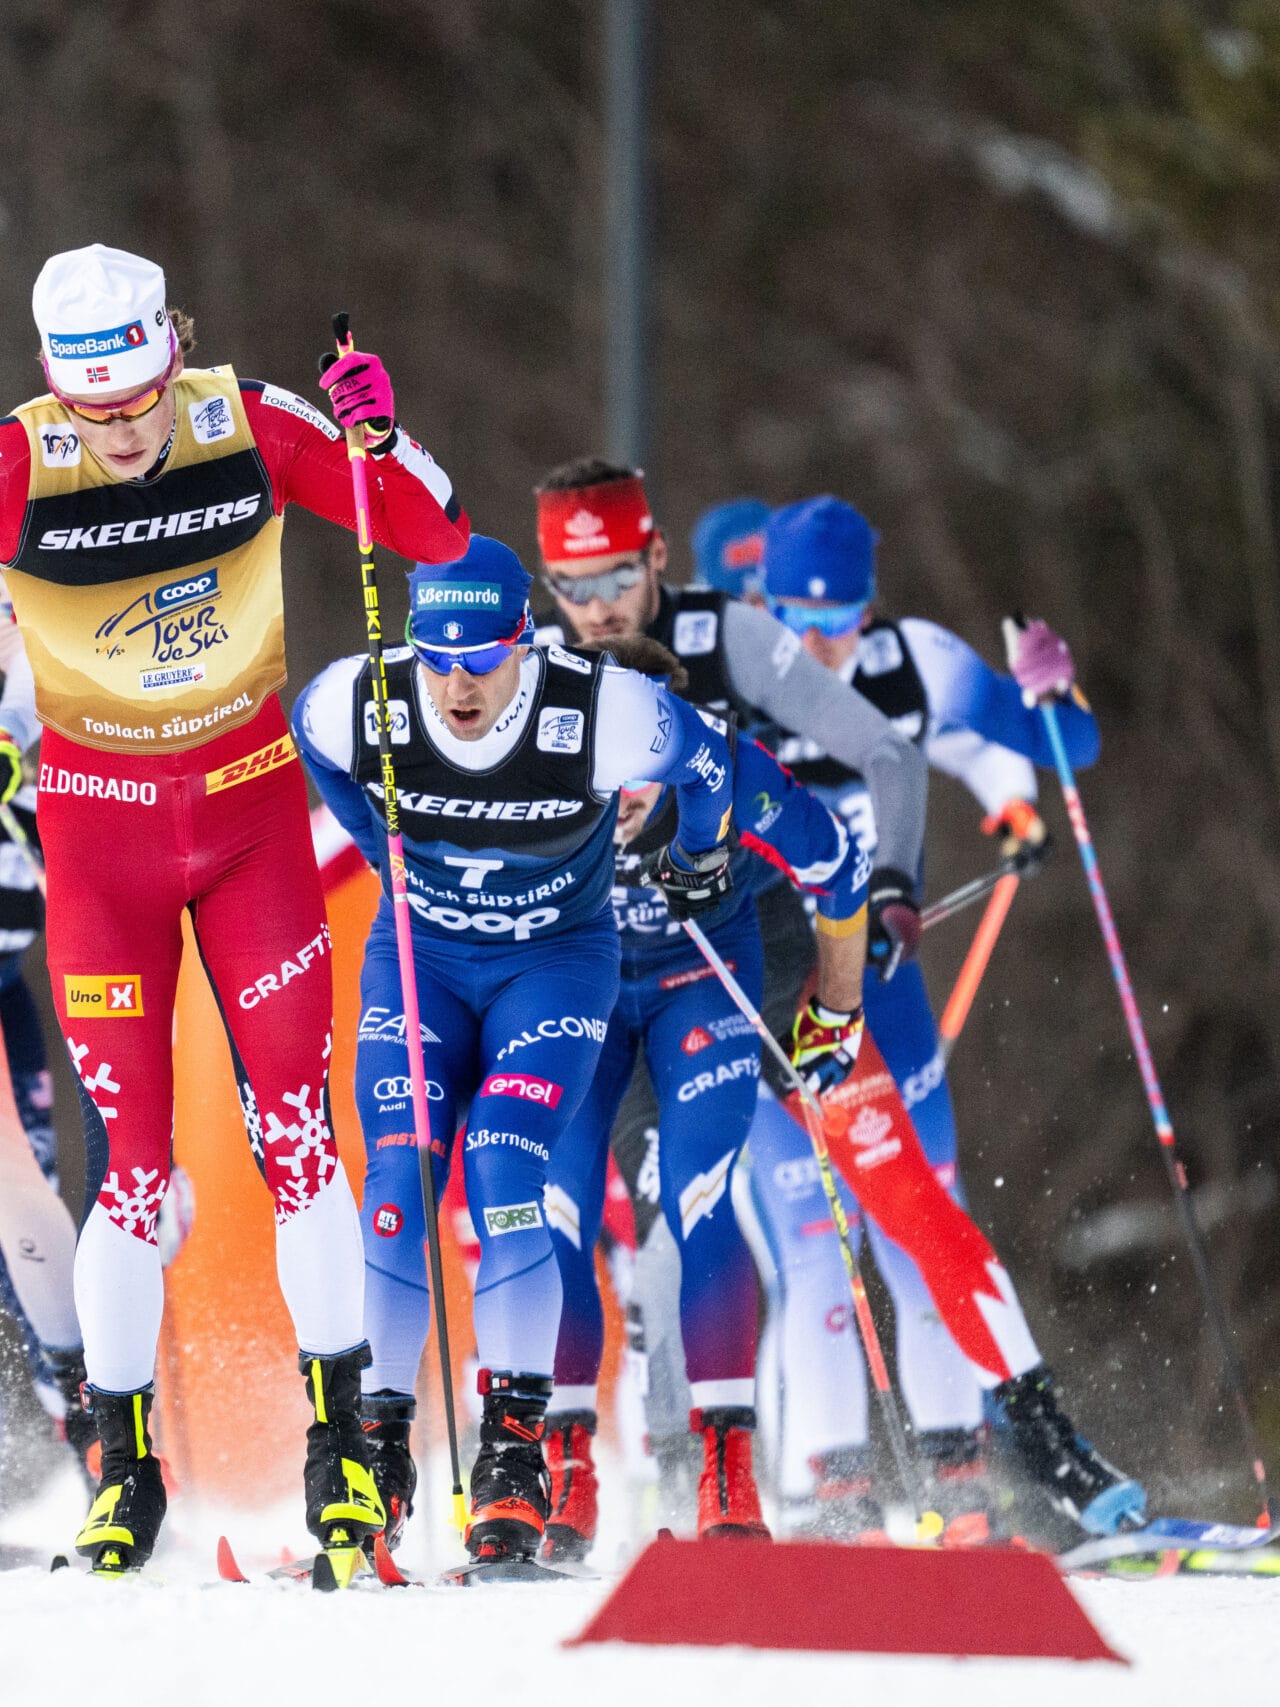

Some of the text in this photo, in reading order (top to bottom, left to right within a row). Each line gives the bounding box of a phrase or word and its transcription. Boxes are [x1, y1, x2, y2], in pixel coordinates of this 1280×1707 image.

[50, 334, 126, 357] SpareBank
[263, 393, 336, 440] TORGHATTEN
[38, 494, 261, 550] SKECHERS
[161, 576, 212, 601] coop
[361, 562, 381, 640] LEKI
[158, 640, 184, 663] de
[143, 674, 154, 684] LE
[82, 717, 155, 740] Toblach
[221, 742, 290, 785] DHL
[38, 762, 157, 806] ELDORADO
[443, 855, 505, 889] 7
[238, 933, 326, 1011] CRAFT
[70, 983, 133, 1009] Uno X
[488, 1076, 554, 1105] enel
[677, 1058, 752, 1103] CRAFT
[378, 1101, 406, 1114] Audi
[376, 1132, 447, 1159] FINSTAL
